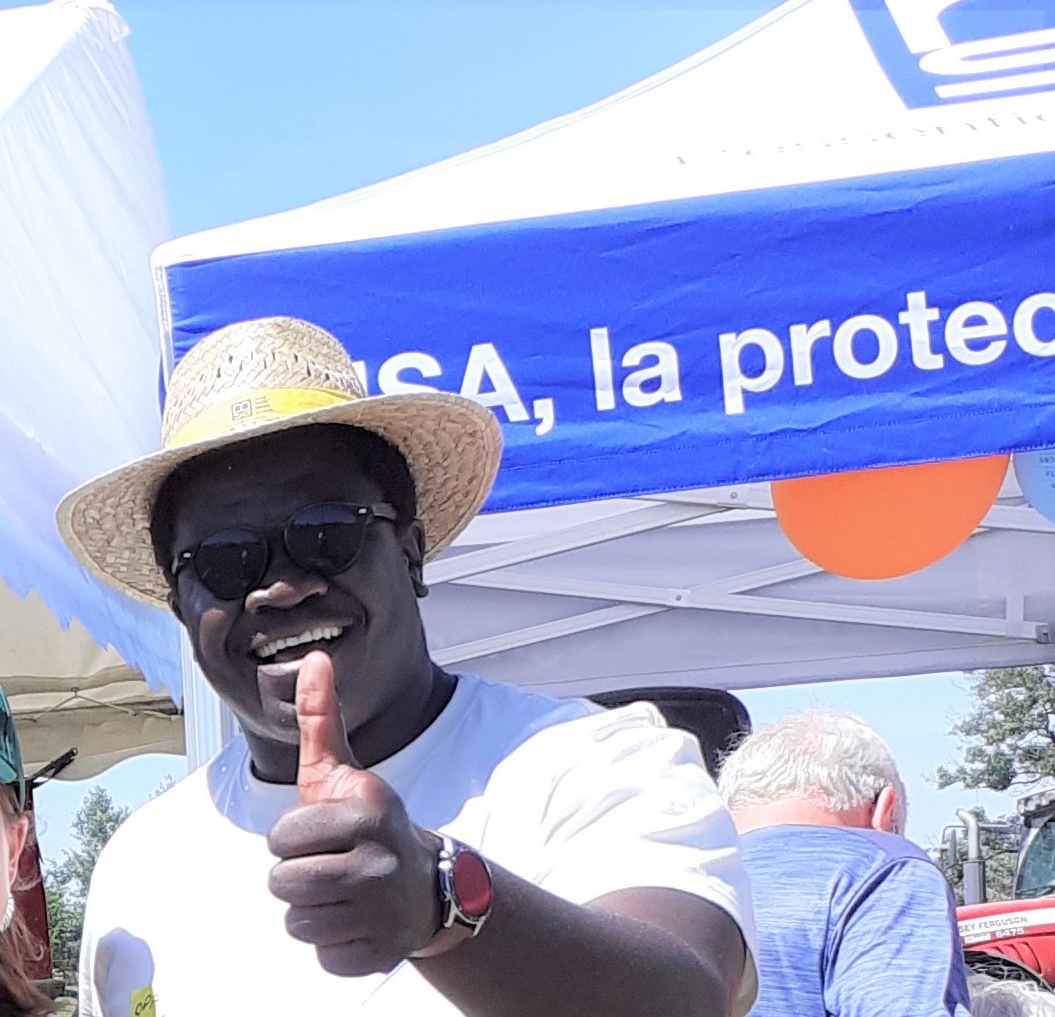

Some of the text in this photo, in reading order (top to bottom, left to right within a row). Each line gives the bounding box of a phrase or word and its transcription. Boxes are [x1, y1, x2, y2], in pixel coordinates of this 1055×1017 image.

[350, 342, 554, 437] SA,
[589, 326, 684, 412] la
[978, 915, 1029, 930] FERGUSON
